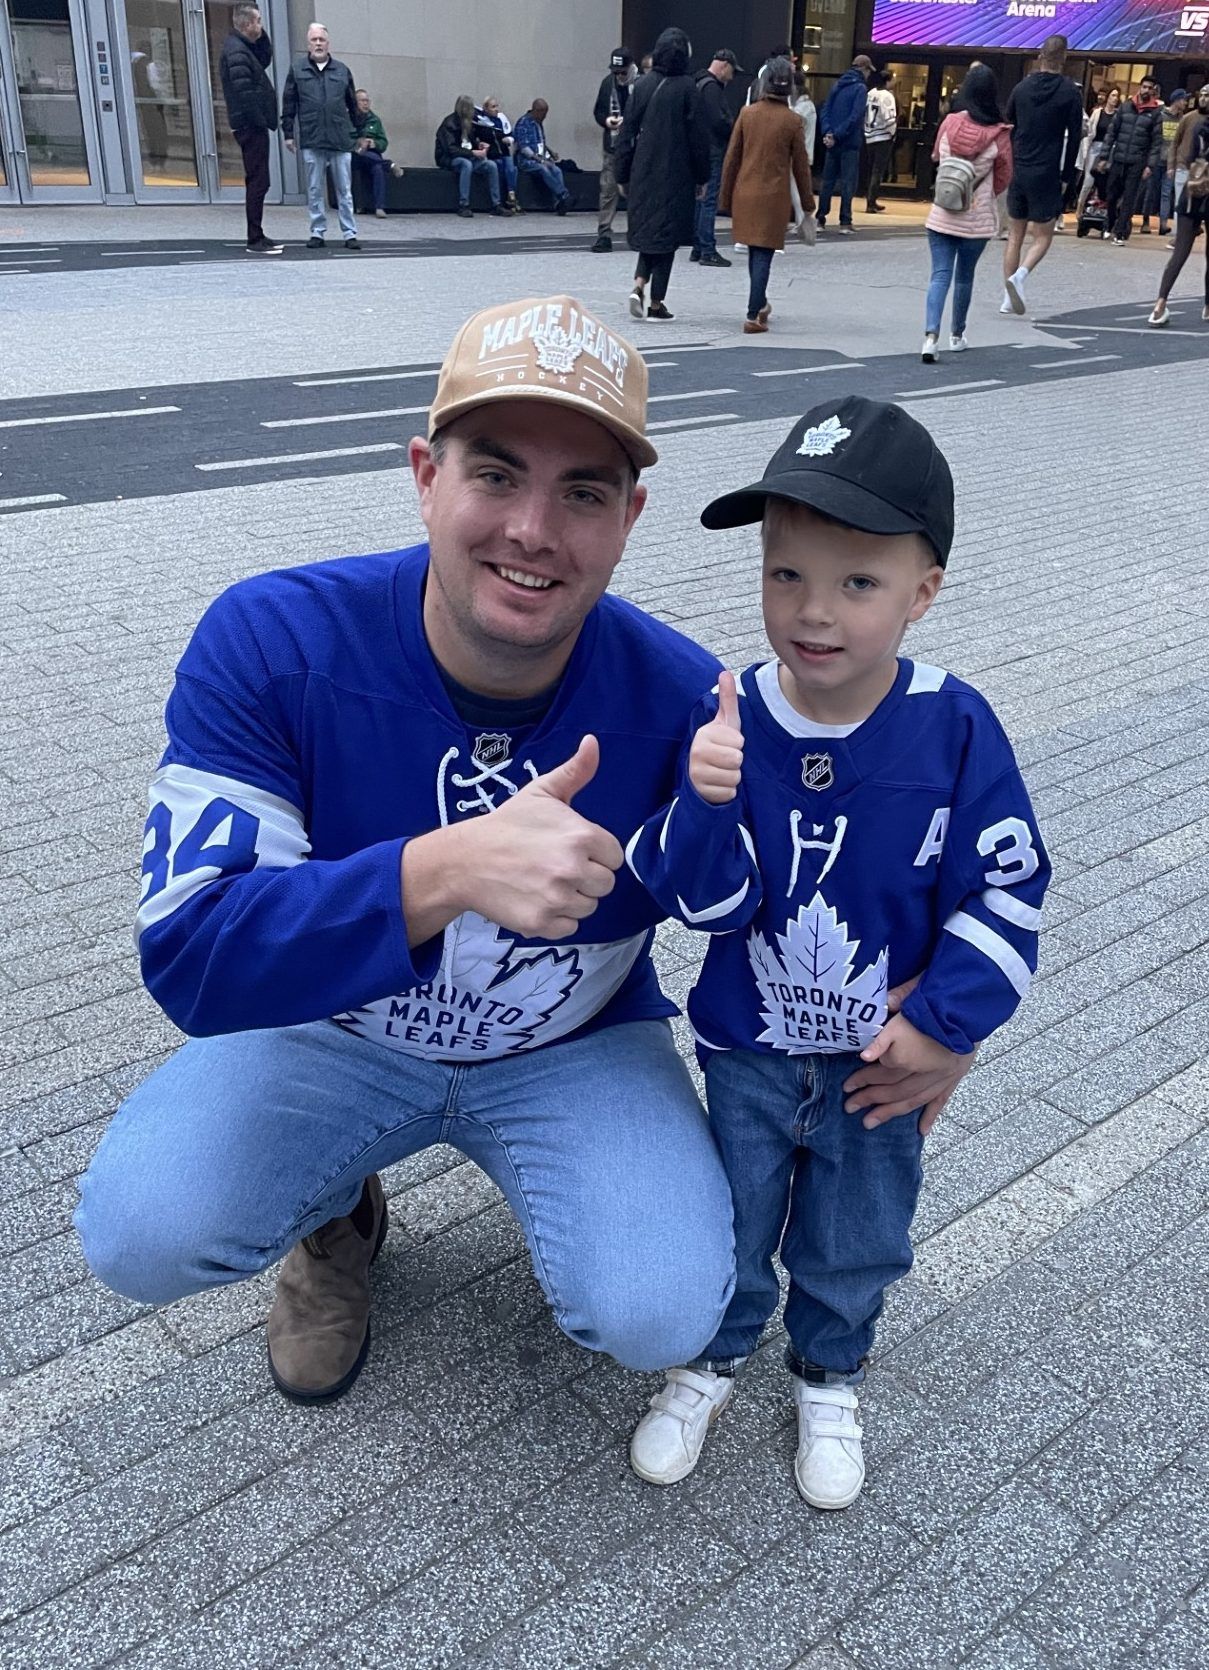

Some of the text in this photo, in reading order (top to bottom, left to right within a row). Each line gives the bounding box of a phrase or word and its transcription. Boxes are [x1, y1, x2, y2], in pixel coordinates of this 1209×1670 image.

[1007, 1, 1056, 17] Arena
[1181, 11, 1209, 30] VS
[478, 304, 628, 388] MAPLE LEAFS
[496, 371, 605, 401] HOCKEY
[481, 742, 503, 760] NHL
[809, 761, 828, 783] NHL
[913, 807, 951, 866] A
[976, 816, 1030, 887] 3
[395, 980, 524, 1025] RONTO
[767, 982, 877, 1023] TORONTO
[389, 999, 494, 1038] MAPLE
[782, 1004, 859, 1035] MAPLE
[784, 1021, 861, 1047] LEAFS
[385, 1020, 489, 1051] LEAFS
